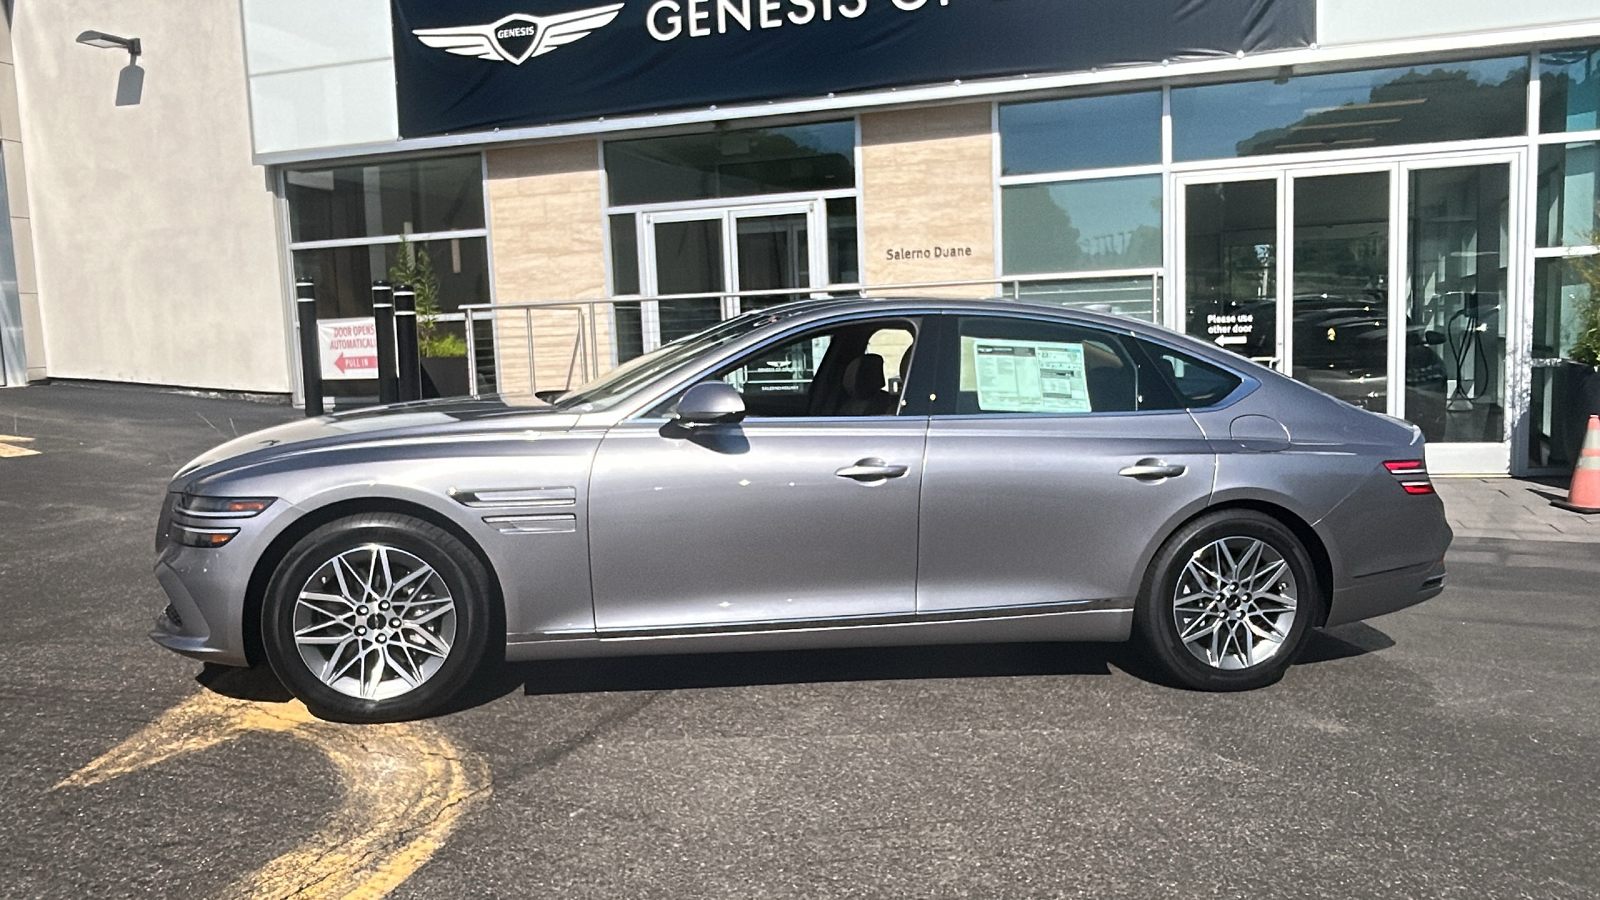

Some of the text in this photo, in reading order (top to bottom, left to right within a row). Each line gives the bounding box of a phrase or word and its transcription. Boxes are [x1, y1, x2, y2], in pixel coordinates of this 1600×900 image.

[497, 26, 535, 39] GENESIS
[886, 246, 972, 260] Salerno Duane
[1207, 314, 1254, 324] Please use
[333, 325, 375, 337] DOOR OPENS
[1207, 324, 1253, 334] other door
[330, 338, 377, 350] AUTOMATICAL
[345, 358, 369, 368] PULL IN
